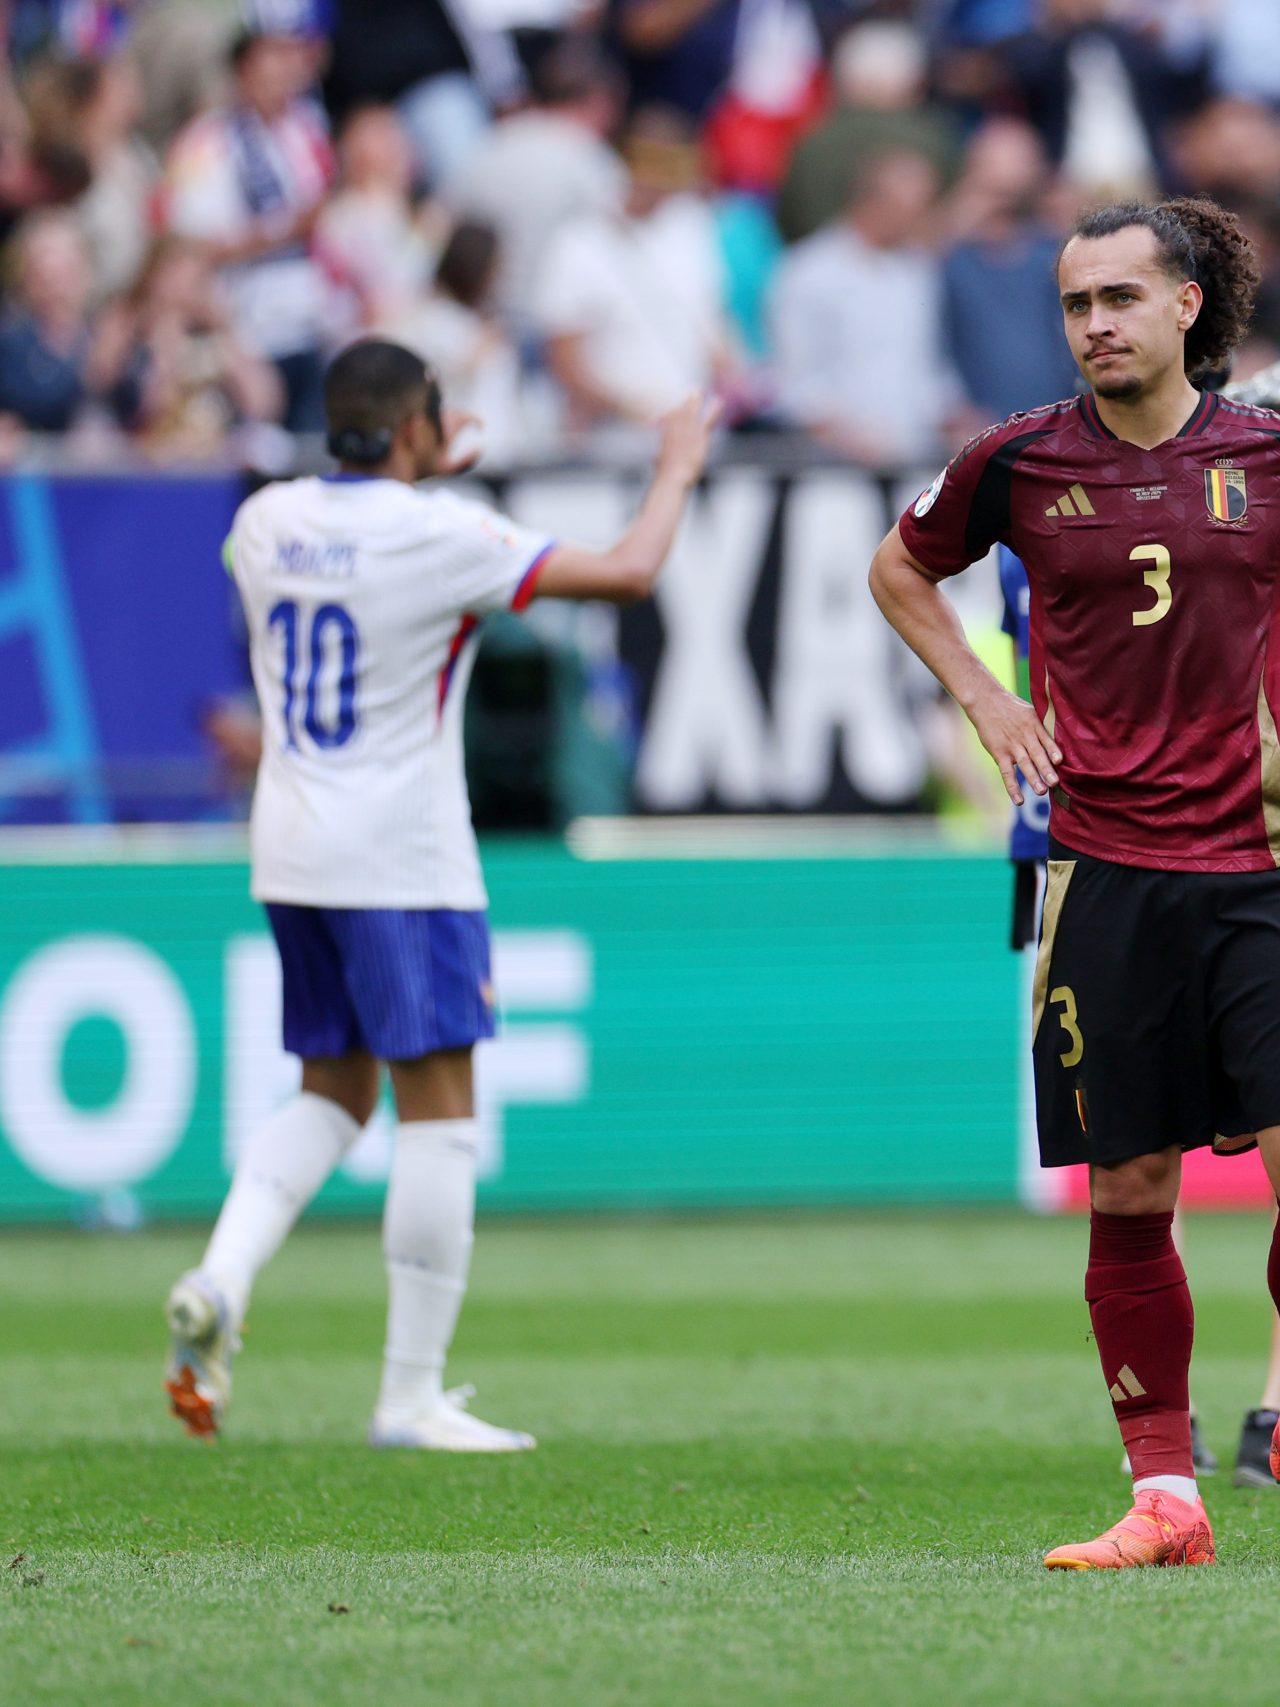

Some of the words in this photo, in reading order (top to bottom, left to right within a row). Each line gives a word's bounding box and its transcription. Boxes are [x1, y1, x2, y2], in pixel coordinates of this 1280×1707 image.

[1129, 544, 1172, 626] 3
[268, 601, 358, 750] 10
[1050, 985, 1084, 1068] 3
